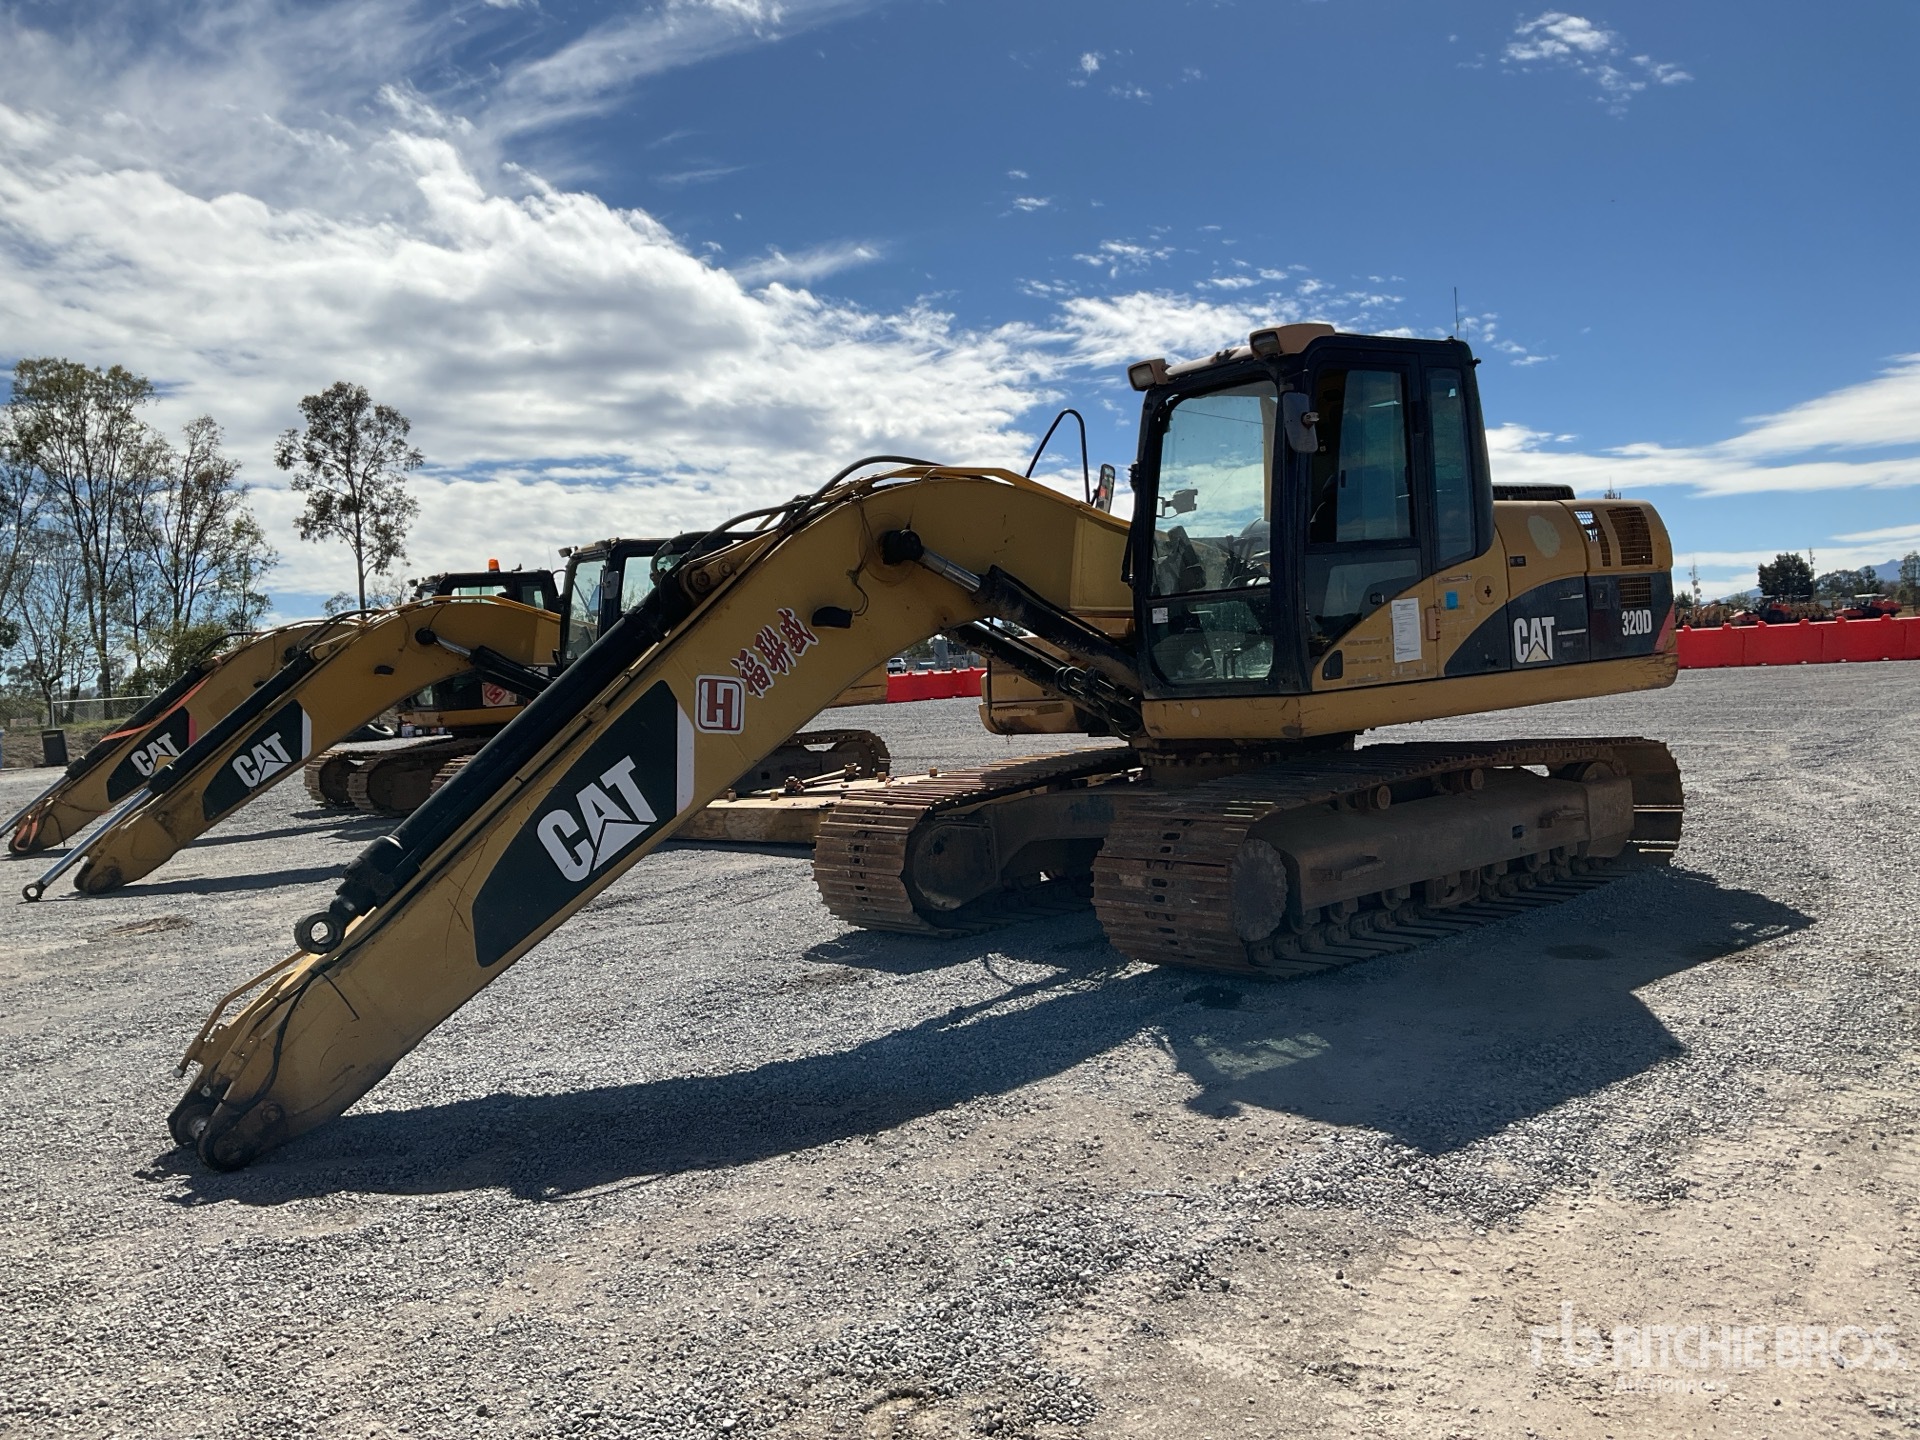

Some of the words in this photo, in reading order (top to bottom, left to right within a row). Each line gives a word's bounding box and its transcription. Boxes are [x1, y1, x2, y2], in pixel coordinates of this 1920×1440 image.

[1513, 616, 1555, 663] CAT
[1621, 609, 1653, 637] 320D
[131, 732, 181, 776] CAT
[232, 732, 292, 788] CAT
[537, 755, 658, 882] CAT
